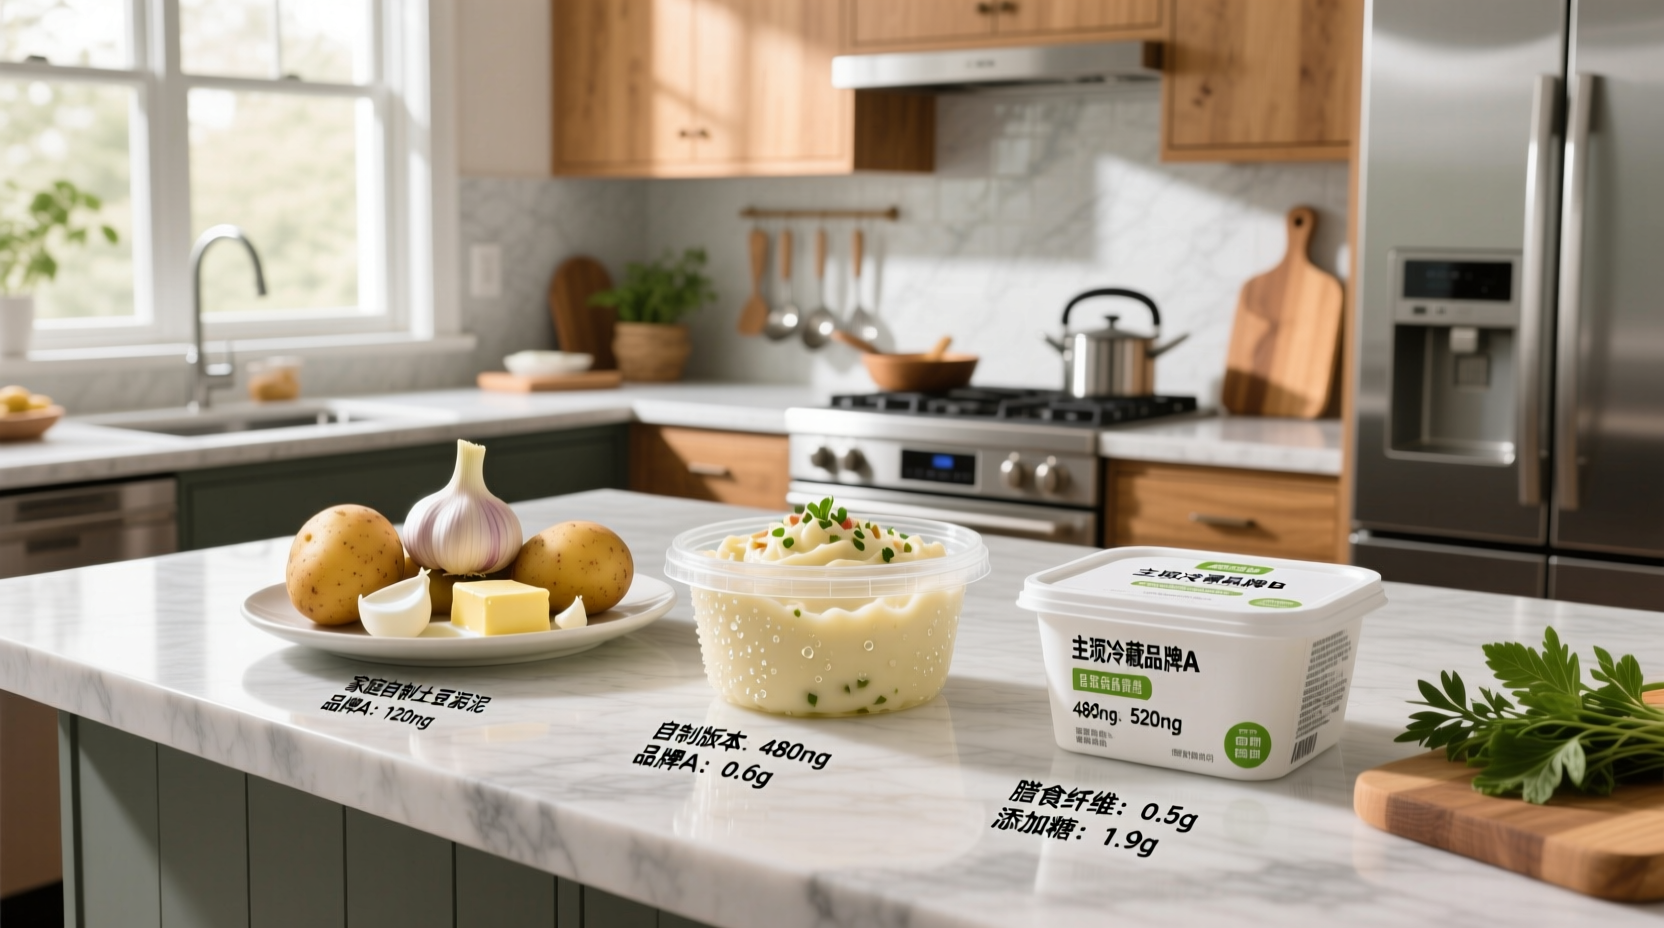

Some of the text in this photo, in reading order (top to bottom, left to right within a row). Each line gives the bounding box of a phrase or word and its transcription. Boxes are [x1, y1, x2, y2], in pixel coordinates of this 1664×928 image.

[1130, 707, 1183, 736] 520ng
[721, 761, 774, 790] 0.6g
[1140, 802, 1199, 833] 0.5g
[1103, 827, 1160, 859] 1.9g
